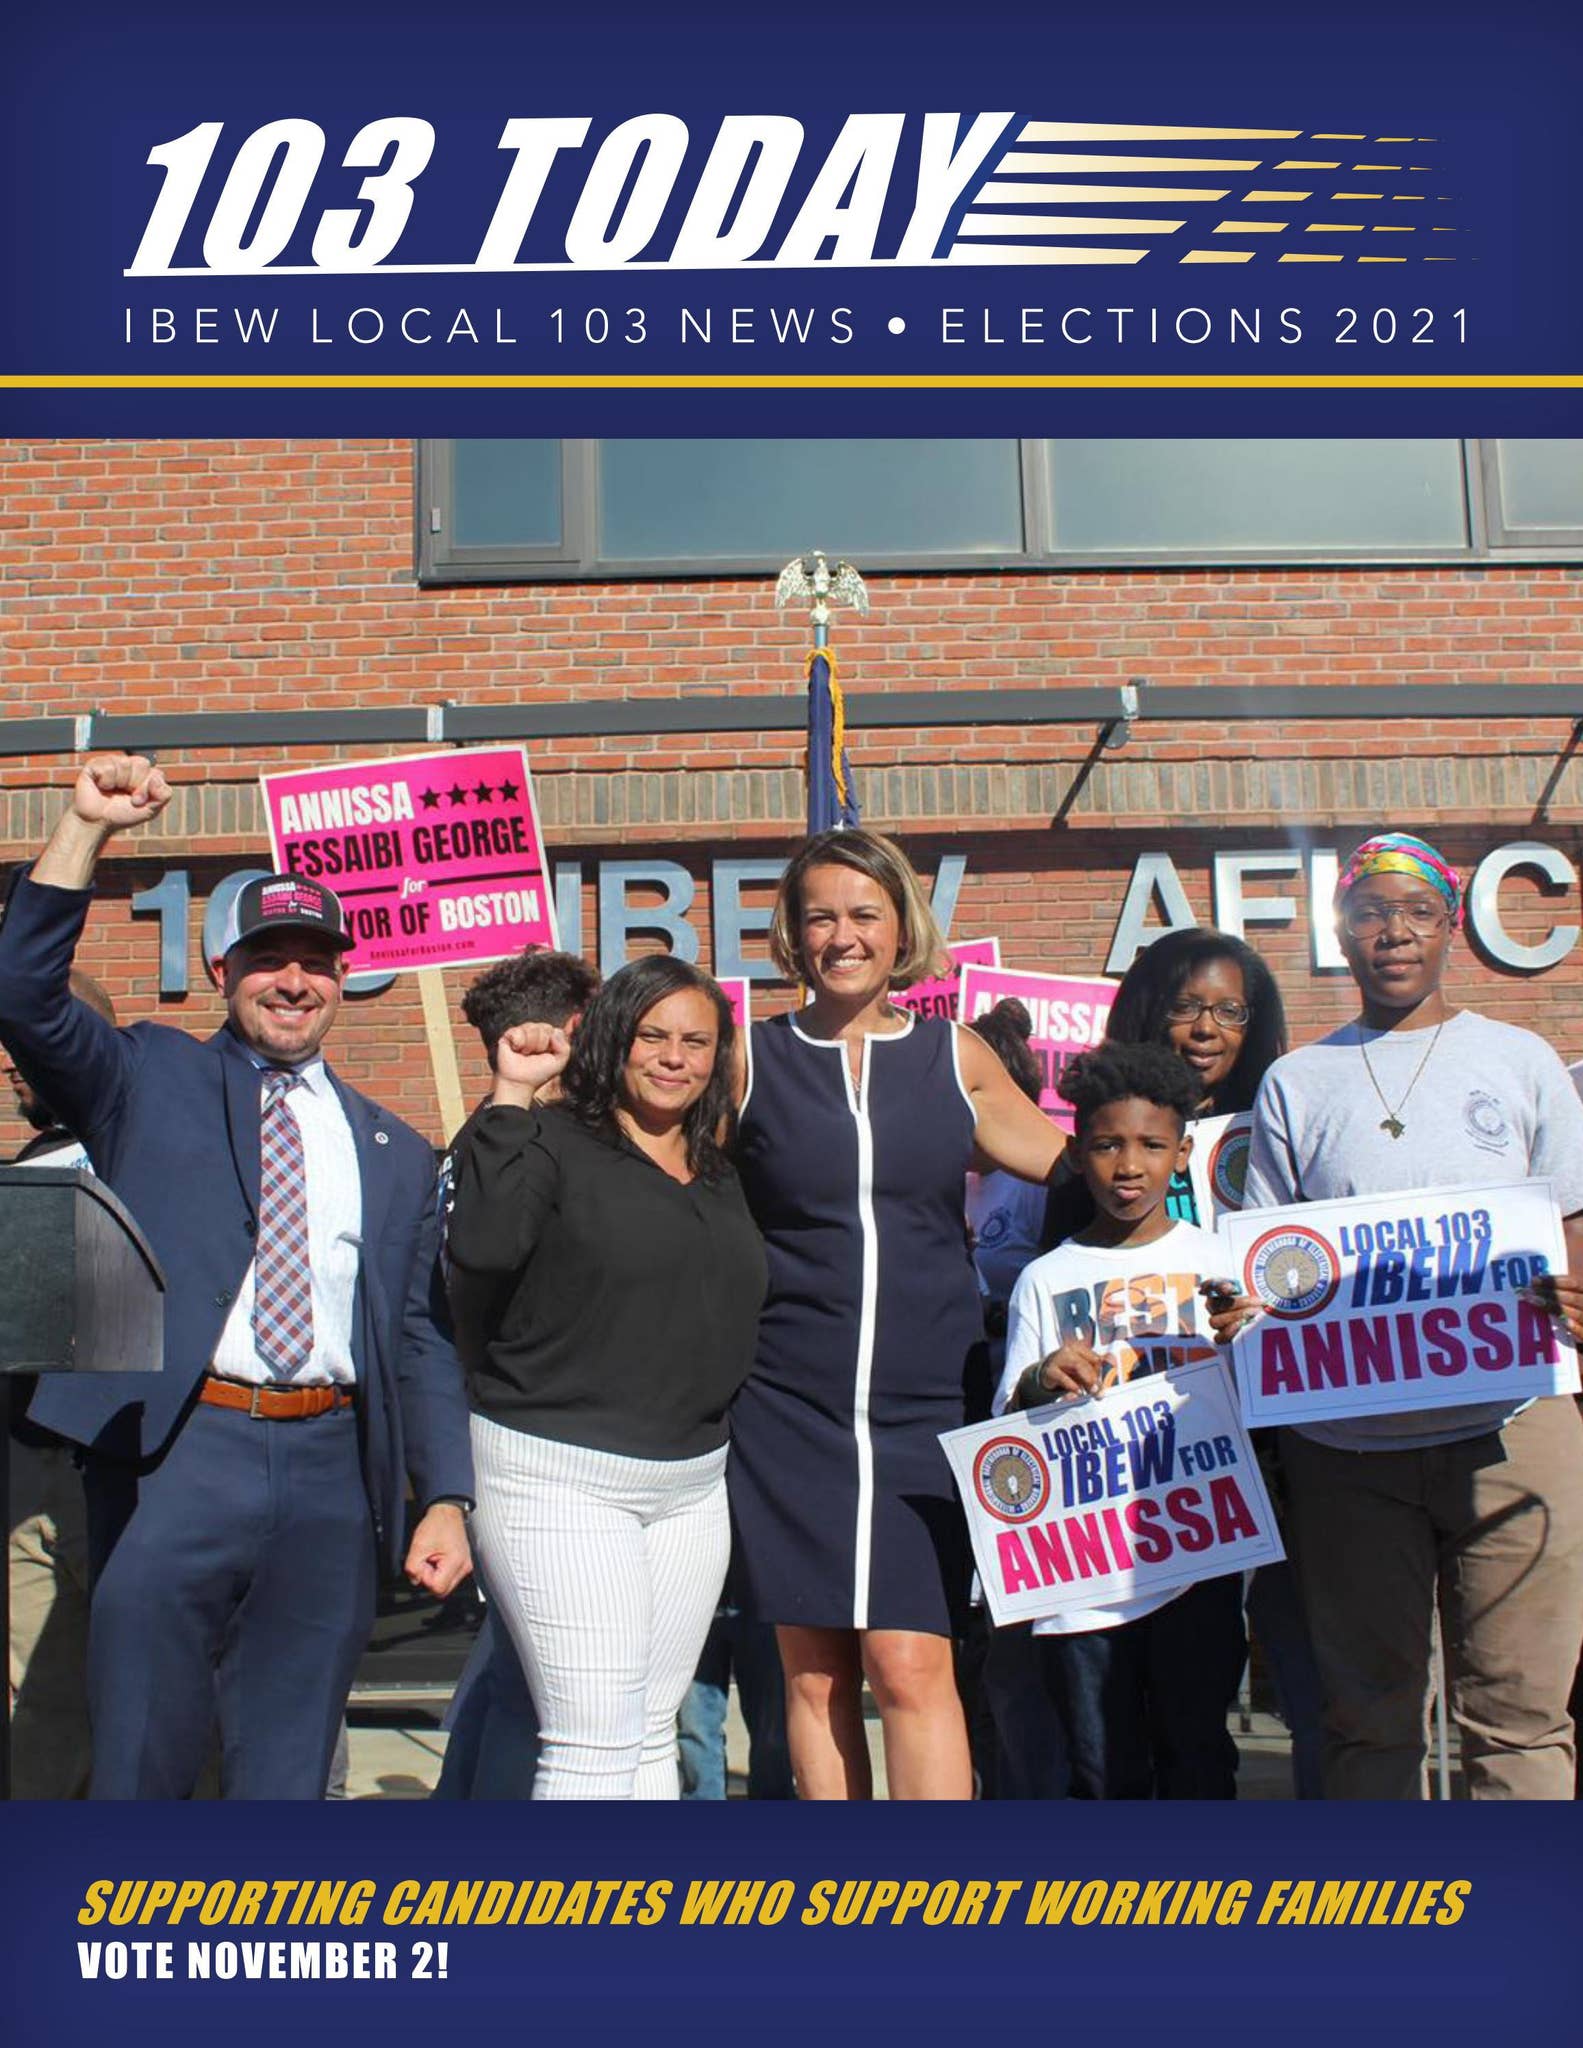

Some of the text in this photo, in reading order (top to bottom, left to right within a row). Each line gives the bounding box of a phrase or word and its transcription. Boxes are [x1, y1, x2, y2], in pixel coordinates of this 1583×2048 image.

[279, 781, 415, 835] ANNISSA
[286, 816, 529, 878] ESSAIBI GEORGE
[400, 902, 430, 936] OF
[439, 890, 540, 931] BOSTON
[401, 877, 428, 899] for
[1339, 1209, 1493, 1257] LOCAL 103
[1351, 1237, 1492, 1309] IBEW
[1052, 1273, 1202, 1348] BEST
[1260, 1299, 1560, 1396] ANNISSA
[1041, 1399, 1175, 1461] LOCAL 103
[1060, 1428, 1176, 1508] IBEW
[1178, 1435, 1238, 1477] FOR
[995, 1475, 1261, 1595] ANNISSA
